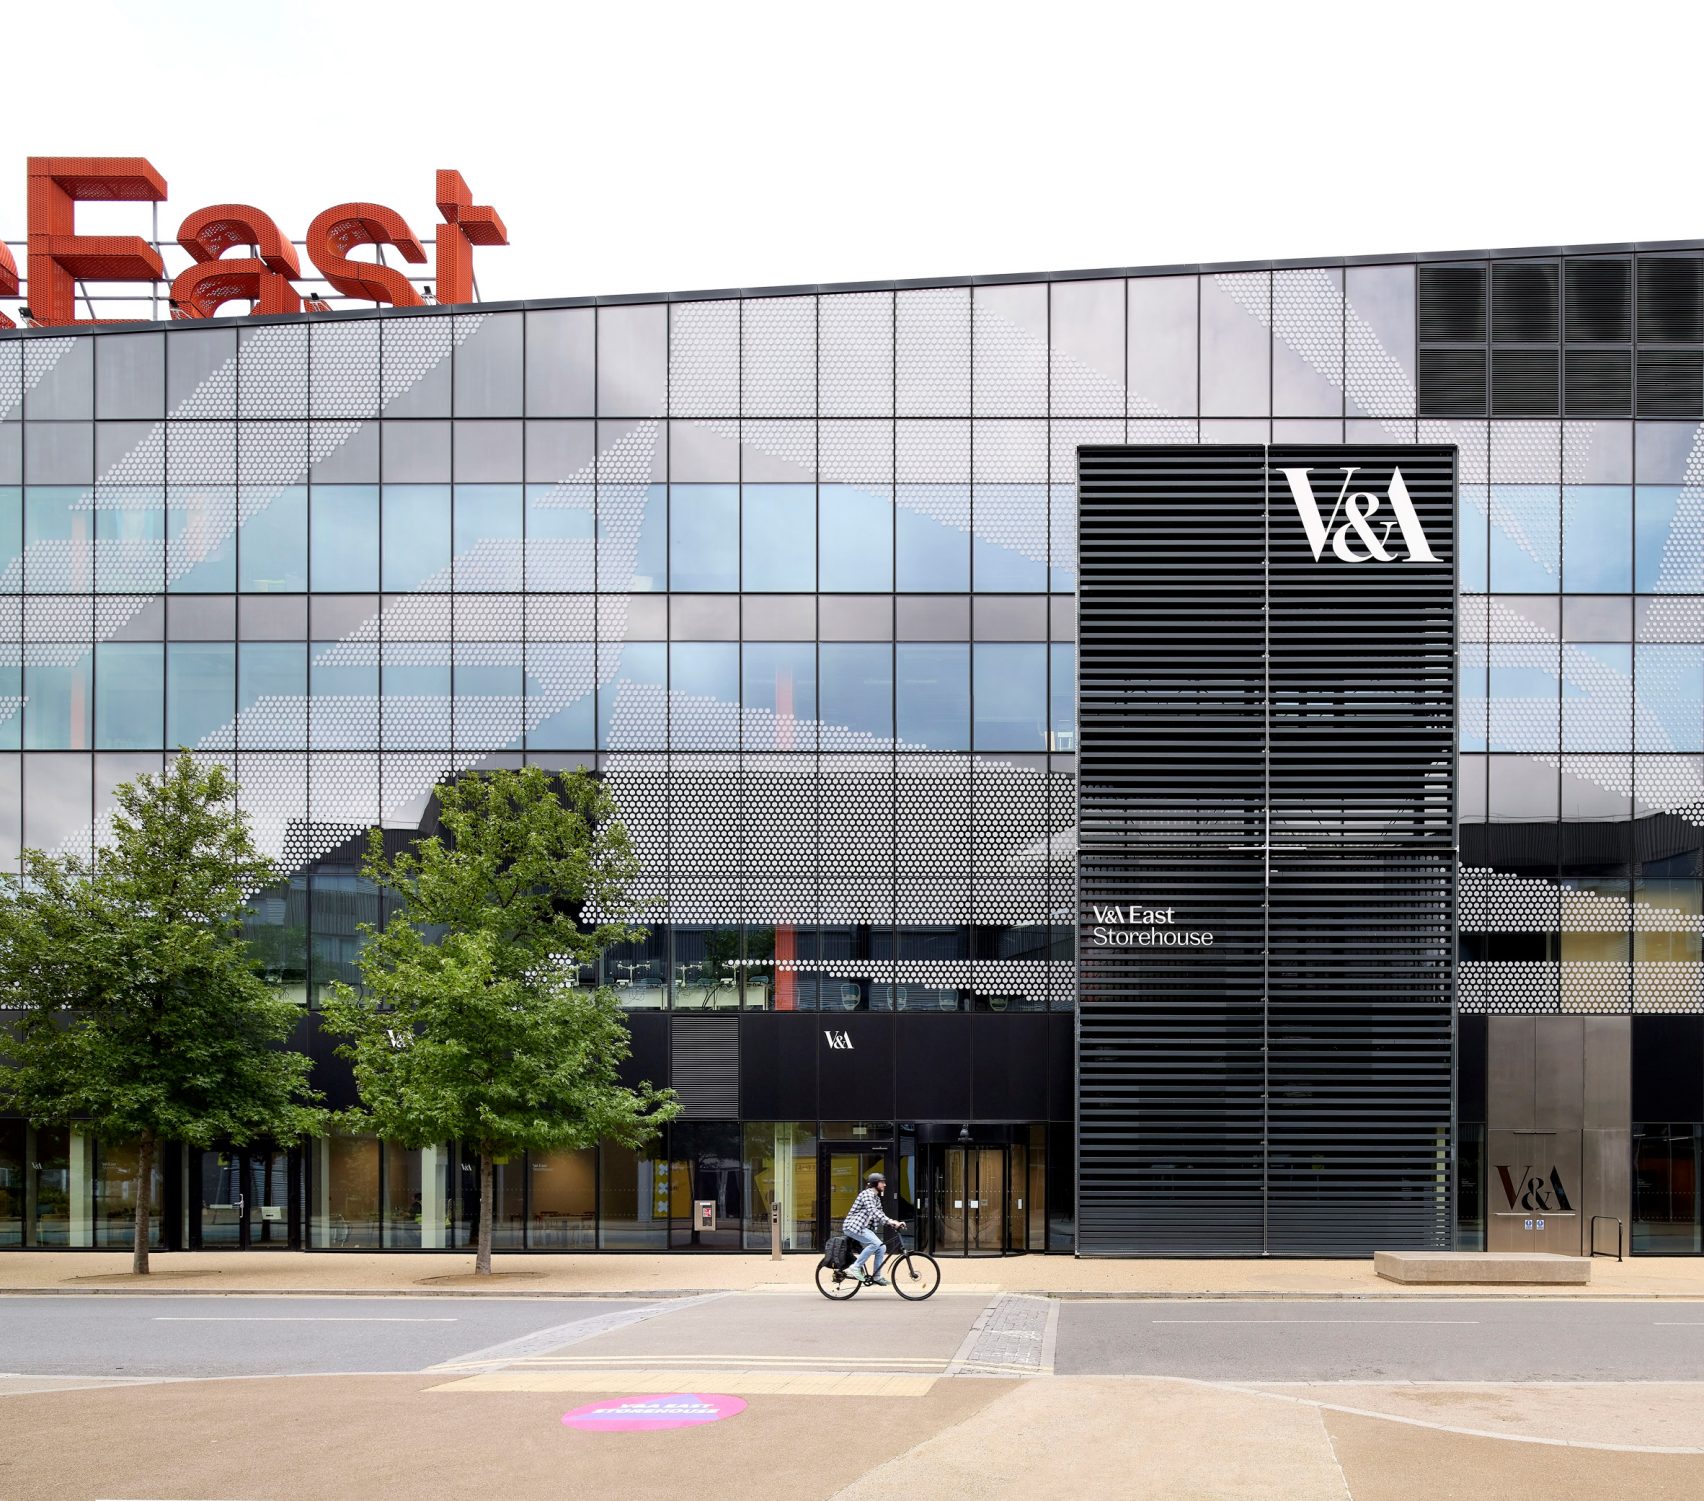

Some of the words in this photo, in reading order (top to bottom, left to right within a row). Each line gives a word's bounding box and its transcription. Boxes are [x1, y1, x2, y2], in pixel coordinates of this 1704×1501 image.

[27, 157, 509, 327] East
[1276, 466, 1444, 563] V&A
[1093, 905, 1125, 924] V&A
[1129, 905, 1175, 924] East
[1093, 926, 1213, 946] Storehouse
[824, 1030, 855, 1050] V&A
[1493, 1165, 1576, 1211] V&A
